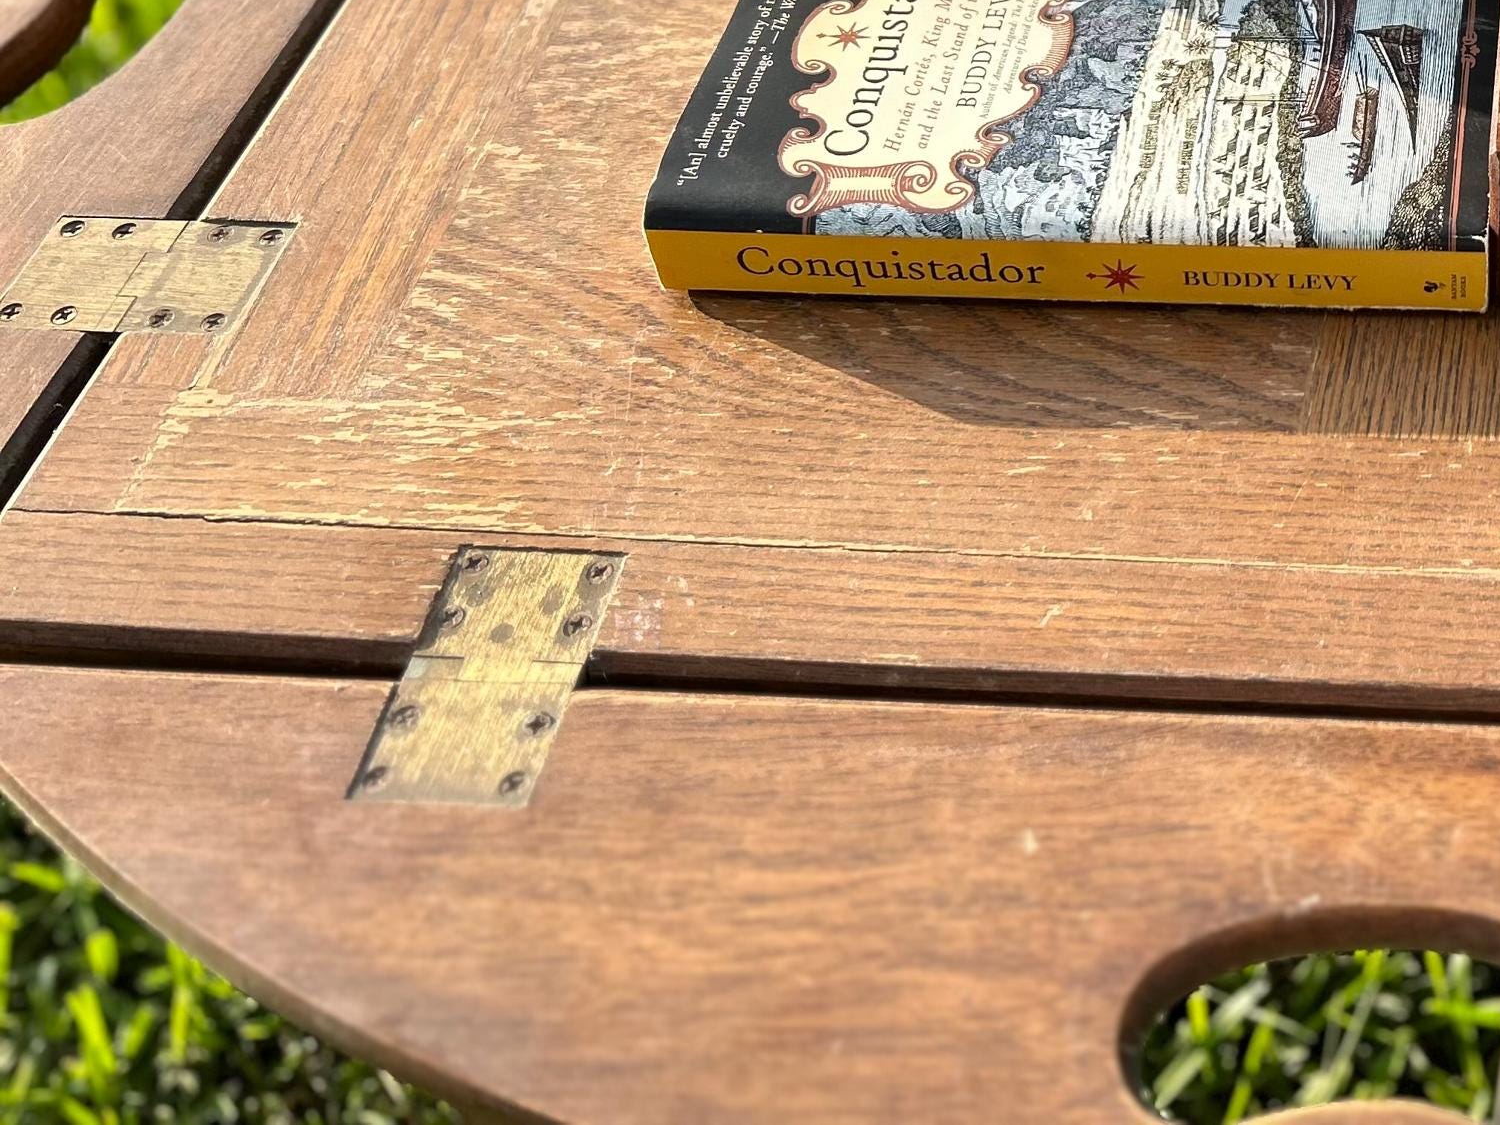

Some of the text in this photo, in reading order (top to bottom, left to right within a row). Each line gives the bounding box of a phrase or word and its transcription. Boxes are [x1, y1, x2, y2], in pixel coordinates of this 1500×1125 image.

[757, 3, 773, 19] of
[959, 3, 980, 20] of
[1011, 6, 1023, 18] The
[747, 19, 771, 45] story
[943, 22, 969, 61] Stand
[956, 36, 997, 108] BUDDY
[992, 48, 1009, 81] American
[1003, 55, 1022, 95] Adventures
[1019, 23, 1033, 47] David
[715, 46, 754, 110] unbelievable
[882, 101, 916, 152] Hernán
[904, 53, 937, 97] Cortés,
[921, 15, 952, 48] King
[930, 64, 956, 96] Last
[990, 80, 999, 90] of
[923, 99, 943, 121] the
[979, 90, 997, 120] Author
[694, 111, 723, 149] almost
[717, 118, 746, 159] cruelty
[736, 96, 753, 118] and
[918, 123, 935, 150] and
[736, 245, 1047, 288] Conquistador
[1182, 270, 1359, 292] BUDDY LEVY
